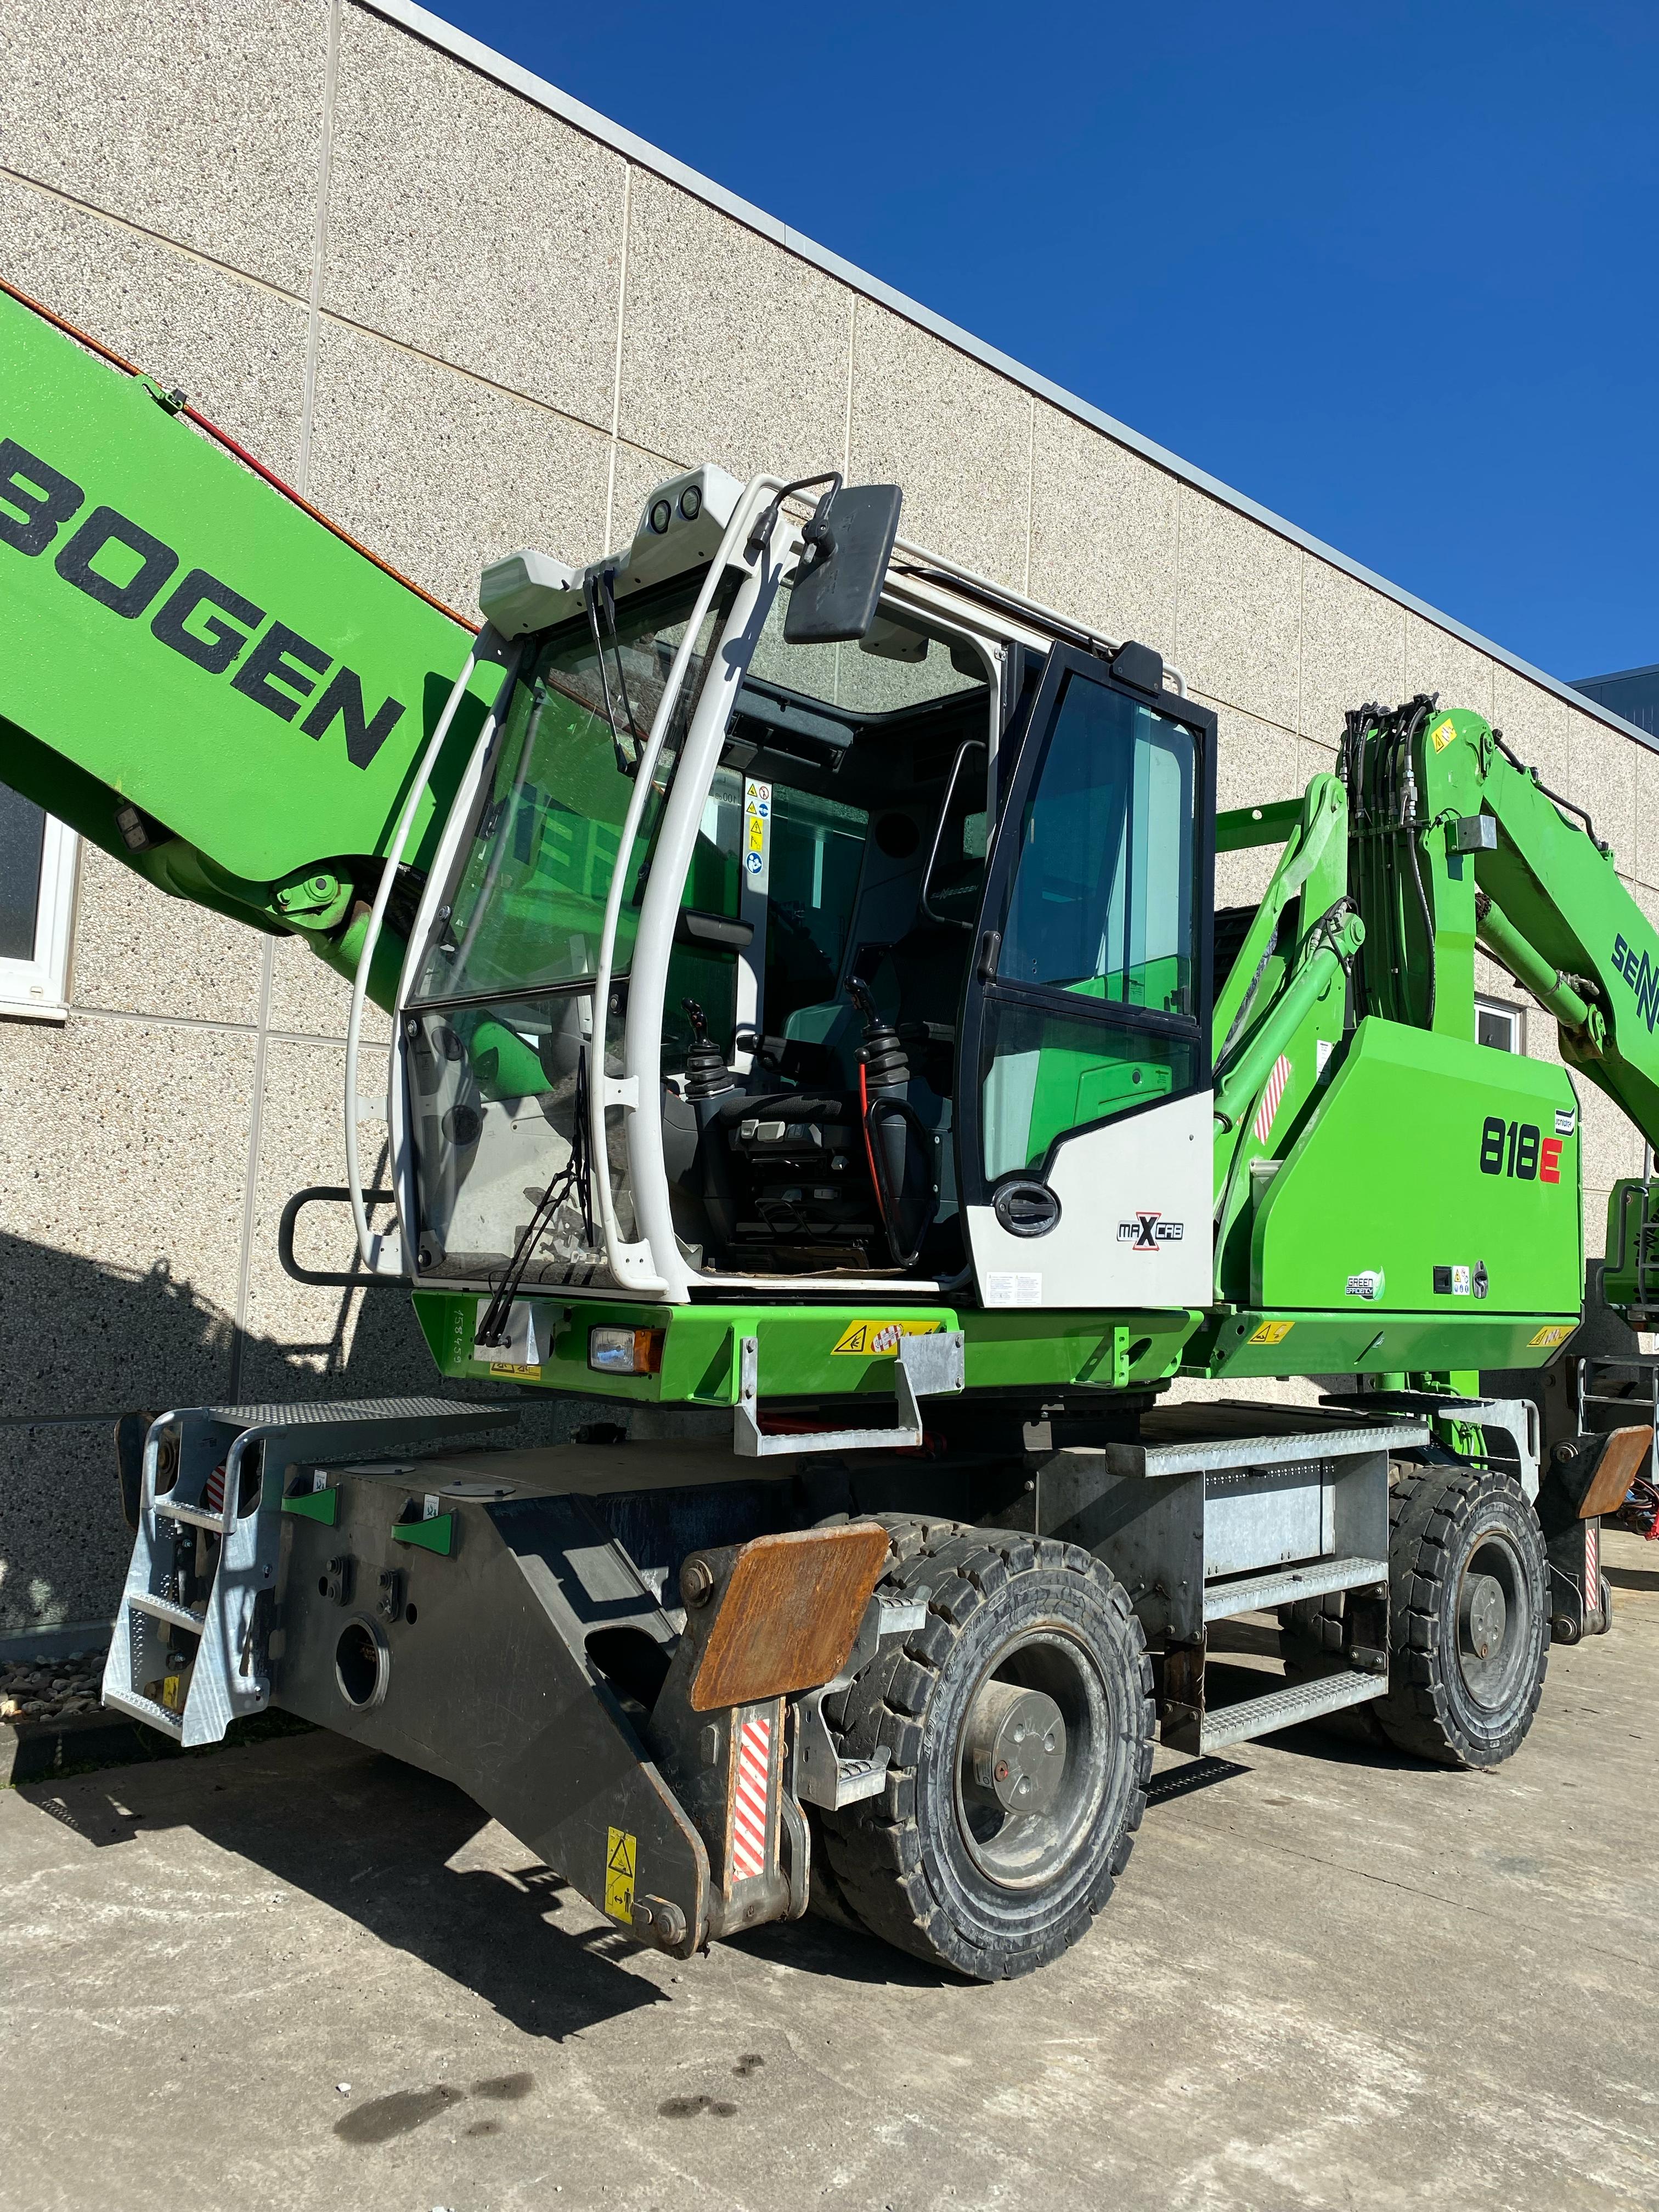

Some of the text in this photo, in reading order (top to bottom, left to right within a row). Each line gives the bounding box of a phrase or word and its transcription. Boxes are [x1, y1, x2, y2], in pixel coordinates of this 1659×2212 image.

[1611, 933, 1659, 1035] SENN
[1480, 1116, 1562, 1184] 818E
[1348, 1278, 1373, 1286] GREEN
